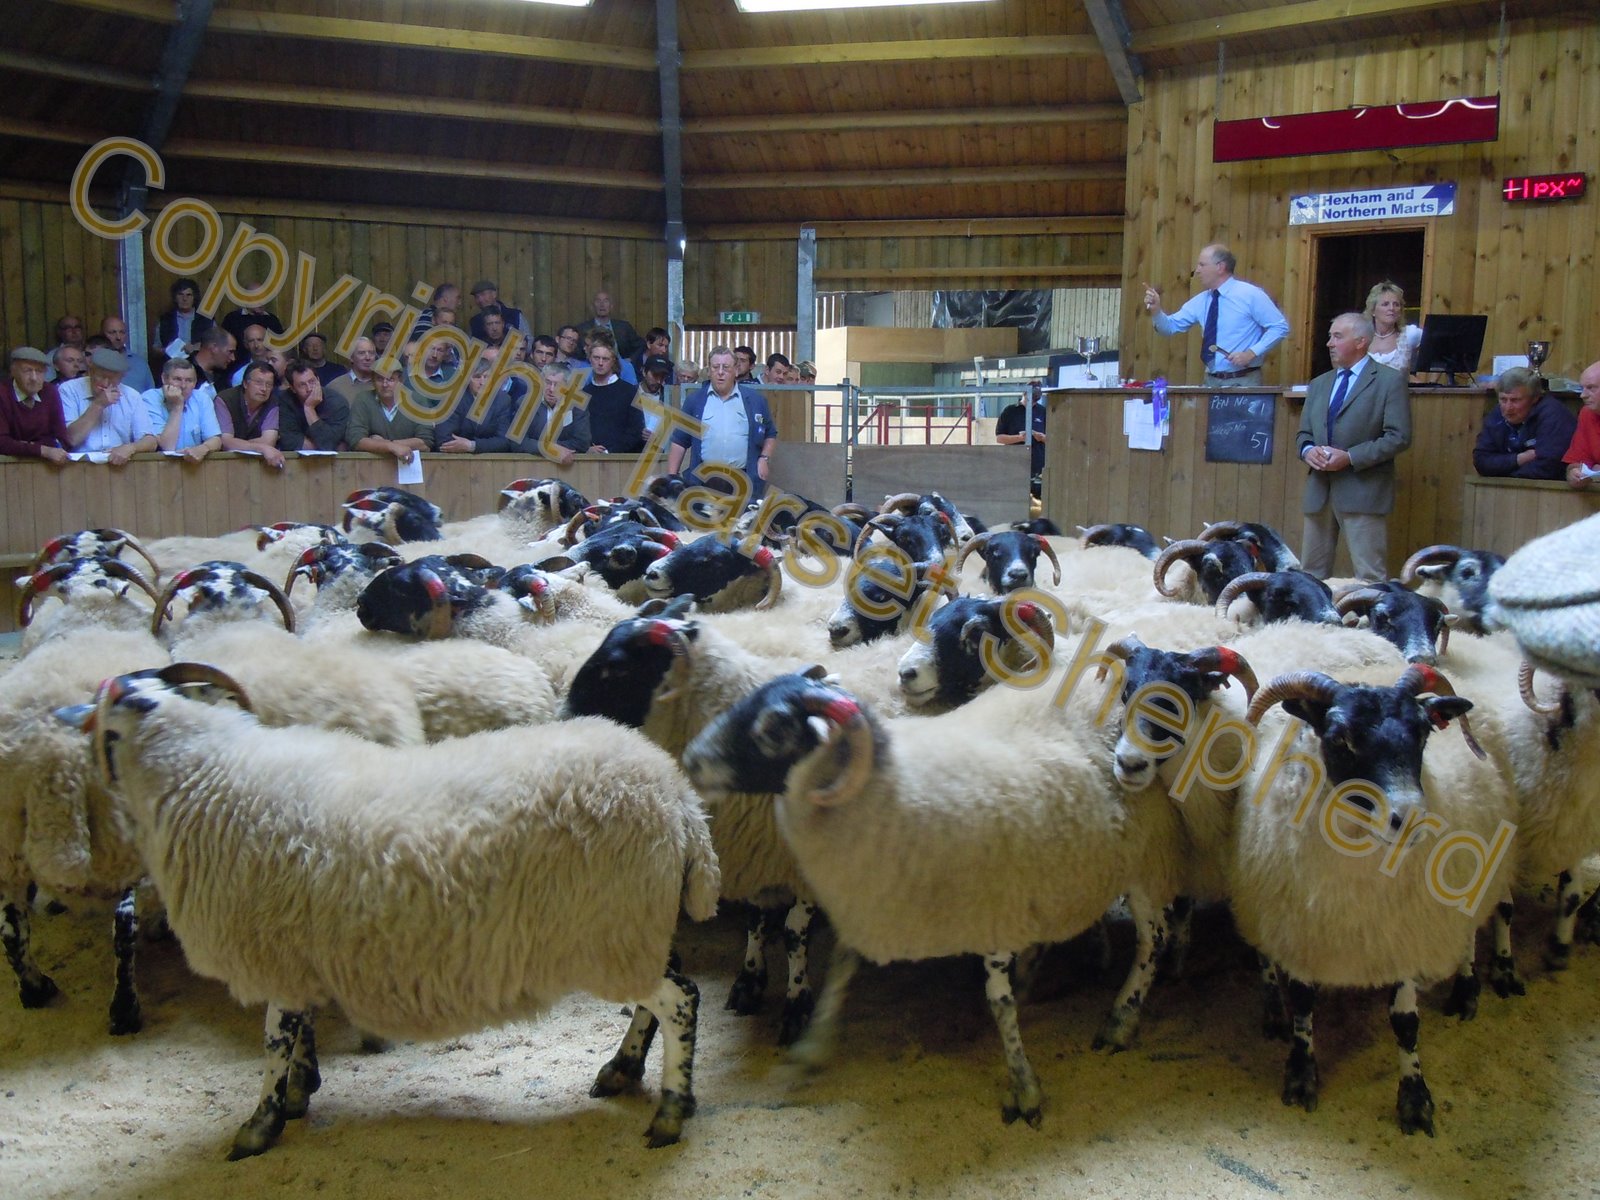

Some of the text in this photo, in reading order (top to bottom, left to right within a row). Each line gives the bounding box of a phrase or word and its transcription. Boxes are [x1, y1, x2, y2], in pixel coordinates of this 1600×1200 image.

[1321, 189, 1415, 207] Hexham and
[1321, 202, 1435, 220] Northern Marts
[1250, 431, 1269, 456] 51
